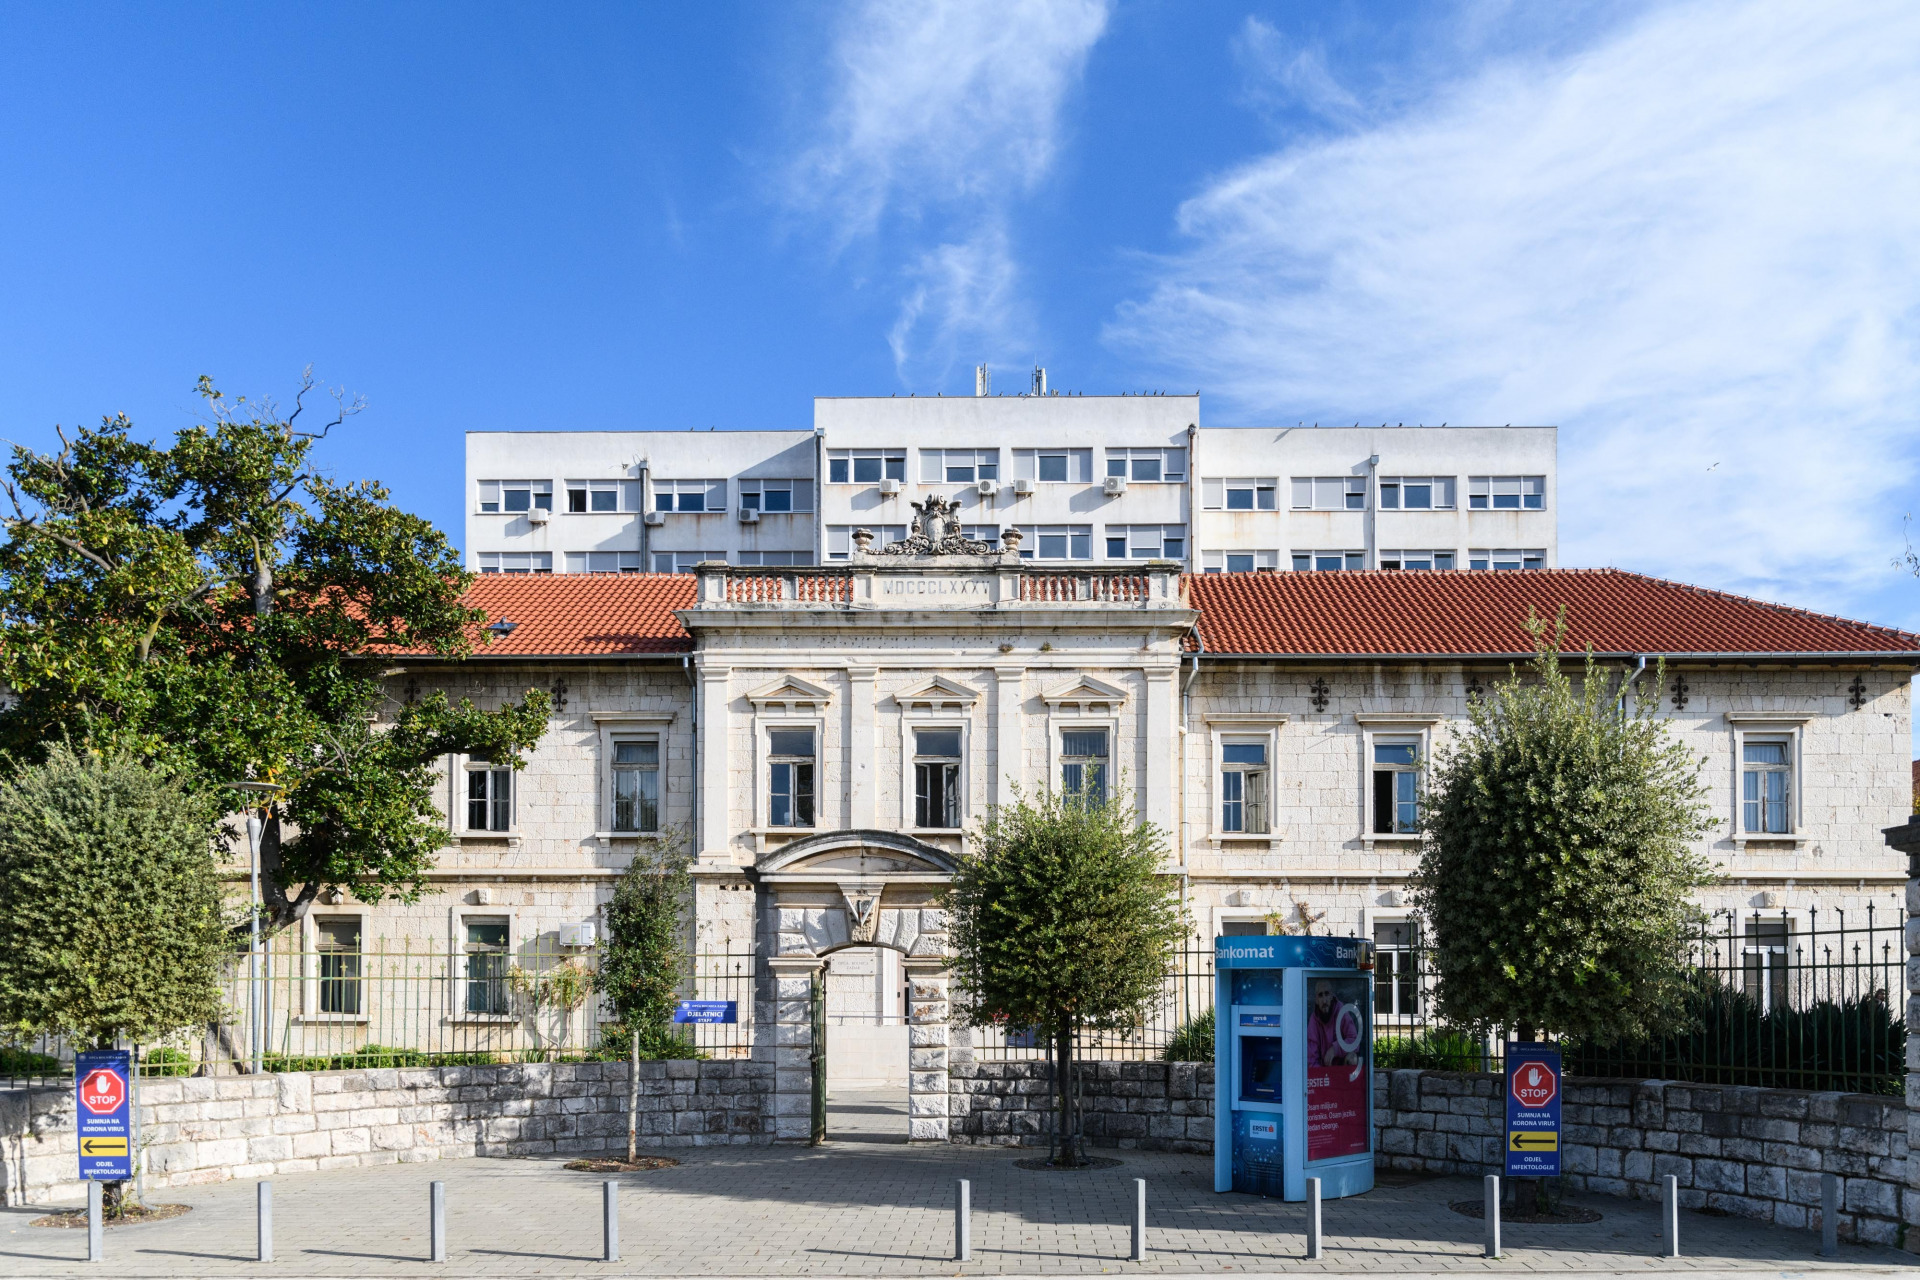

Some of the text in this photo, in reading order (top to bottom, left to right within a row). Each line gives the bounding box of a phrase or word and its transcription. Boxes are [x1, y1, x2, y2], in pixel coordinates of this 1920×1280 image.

[1215, 945, 1274, 959] Bankomat
[1520, 1088, 1548, 1098] STOP
[89, 1095, 117, 1105] STOP
